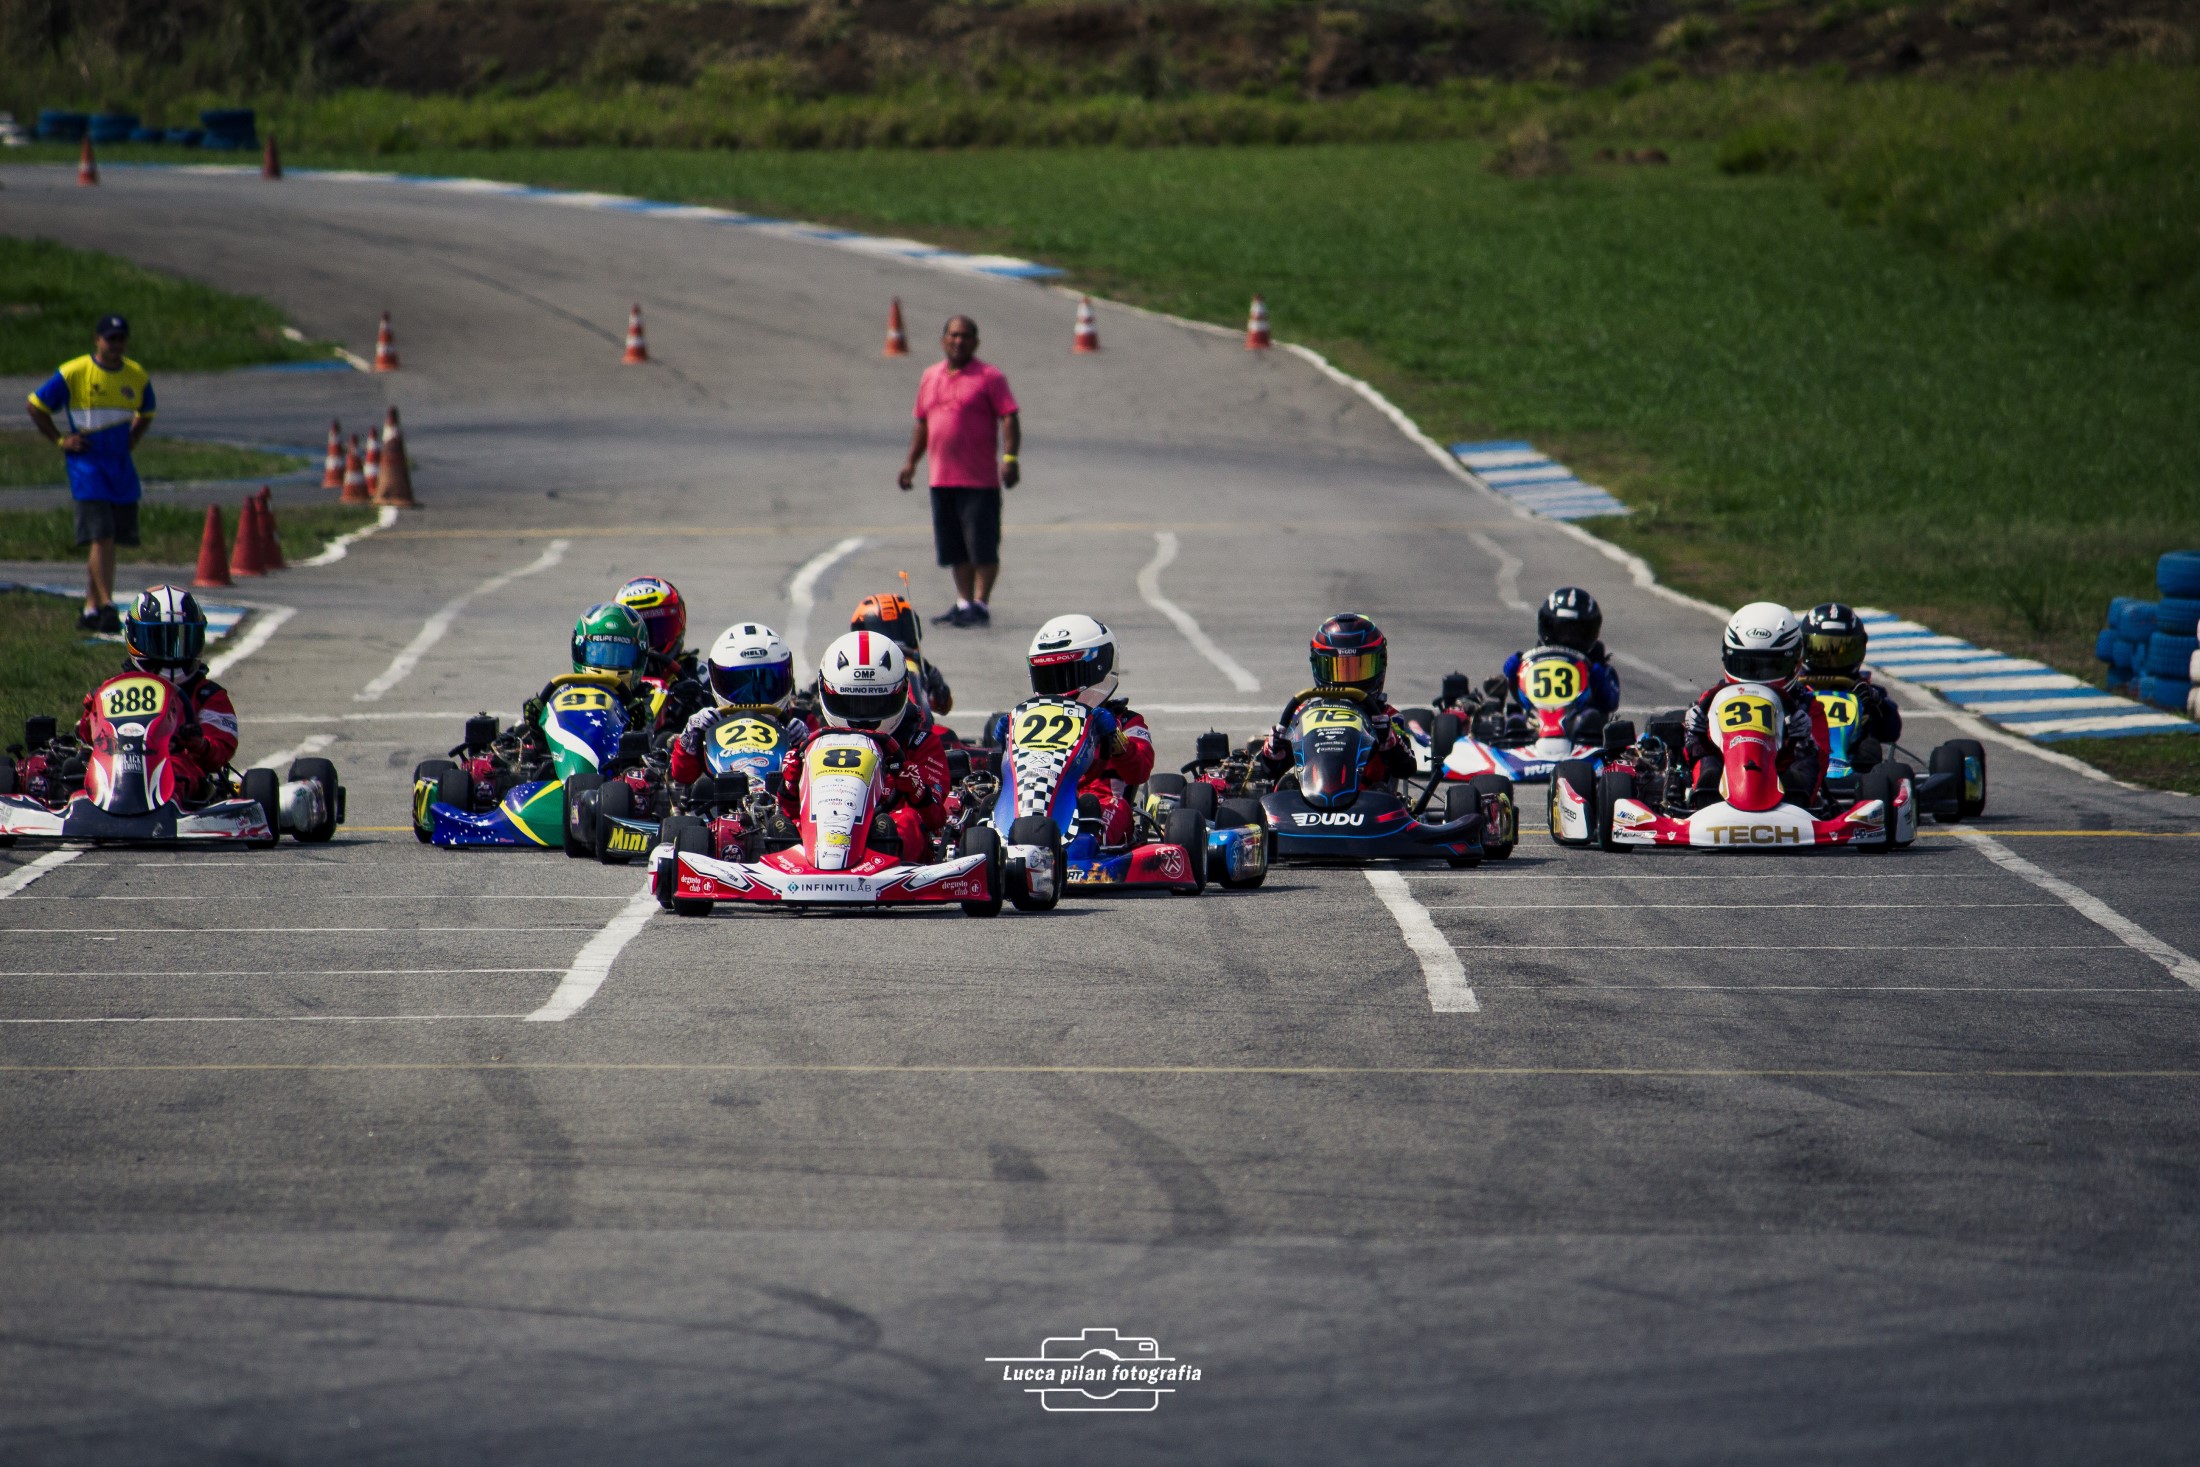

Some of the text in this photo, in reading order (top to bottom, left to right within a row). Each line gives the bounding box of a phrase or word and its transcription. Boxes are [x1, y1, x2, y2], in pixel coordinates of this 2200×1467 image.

[744, 649, 763, 657] HELT
[853, 670, 875, 679] OMP
[1533, 667, 1573, 698] 53
[110, 685, 156, 714] 888
[868, 686, 889, 694] RYBA
[1724, 701, 1773, 730] 31
[1817, 700, 1850, 724] 4
[725, 724, 773, 746] 23
[1020, 714, 1073, 745] 22
[822, 748, 862, 768] 8
[1303, 812, 1364, 826] DUDU
[1706, 825, 1799, 844] TECH
[681, 875, 701, 884] degusto
[942, 880, 968, 890] degusto
[954, 888, 968, 896] club
